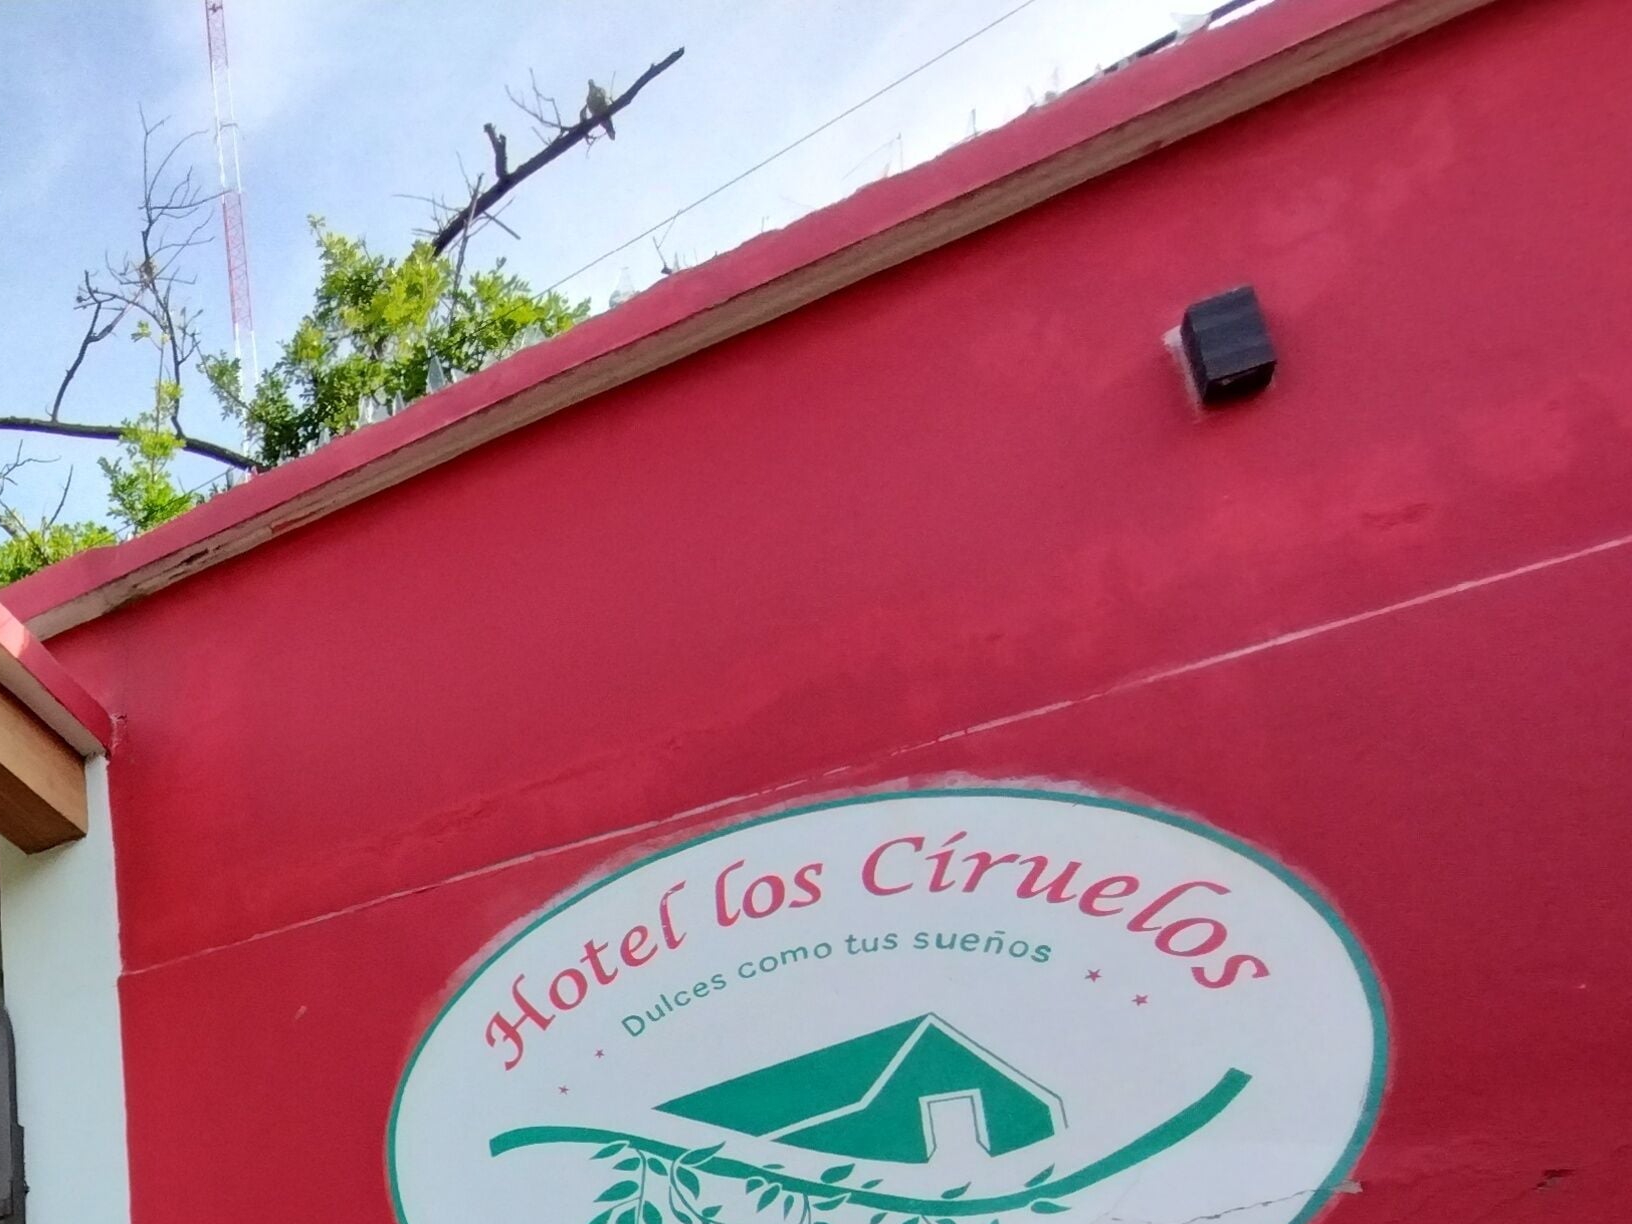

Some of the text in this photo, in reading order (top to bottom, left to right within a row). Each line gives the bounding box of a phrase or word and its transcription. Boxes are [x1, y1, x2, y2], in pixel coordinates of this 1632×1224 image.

[483, 881, 687, 1071] Hotel
[714, 859, 823, 928] los
[621, 928, 1052, 1039] Dulces como tus sueños
